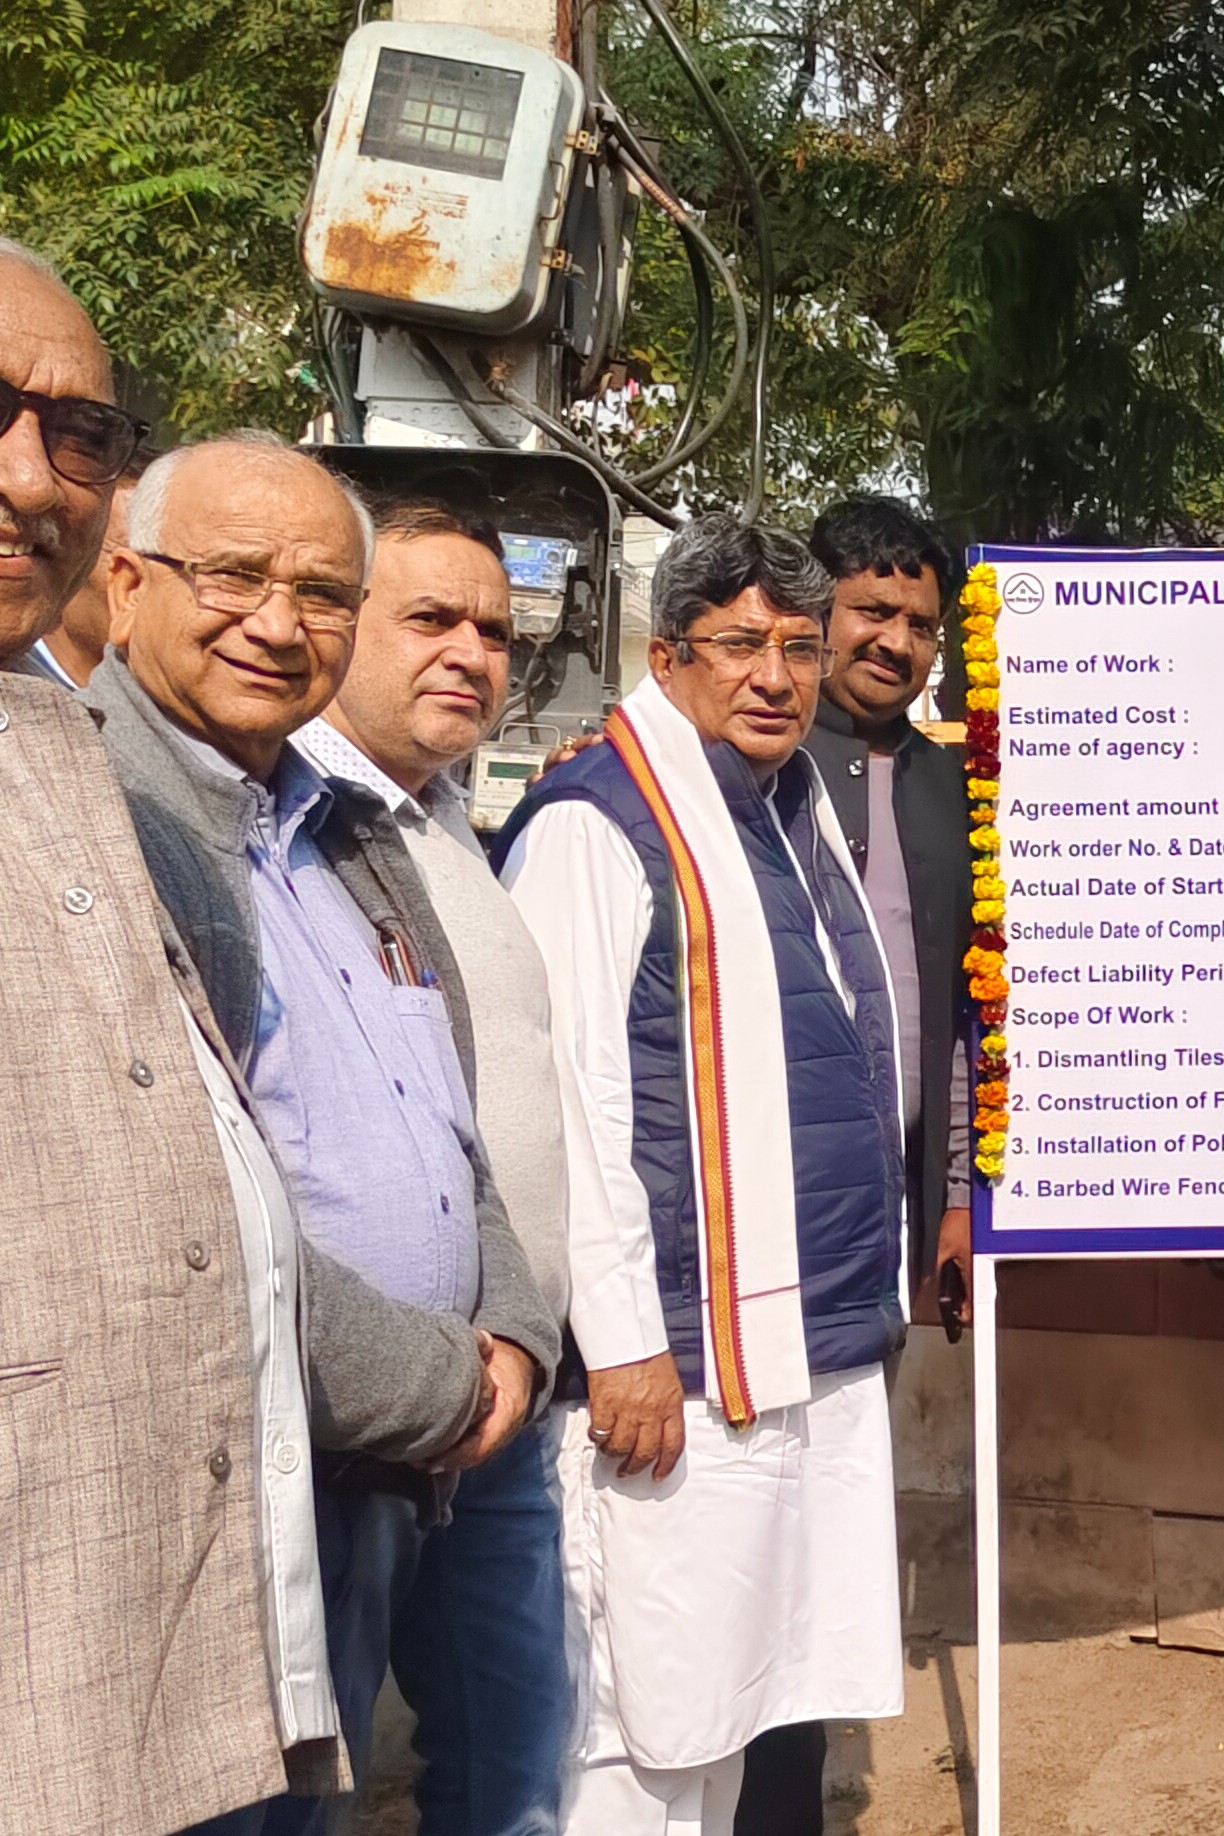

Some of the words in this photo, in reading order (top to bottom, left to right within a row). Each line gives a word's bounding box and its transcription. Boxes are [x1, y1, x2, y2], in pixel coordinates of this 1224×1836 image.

[1007, 656, 1068, 673] Name
[1076, 655, 1098, 673] of
[1104, 655, 1160, 672] Work
[1168, 658, 1174, 673] :
[1009, 706, 1117, 724] Estimated
[1126, 706, 1176, 724] Cost
[1183, 709, 1189, 724] :
[1010, 739, 1070, 756] Name
[1079, 738, 1100, 756] of
[1107, 742, 1184, 760] agency
[1193, 741, 1199, 755] :
[1009, 799, 1130, 821] Agreement
[1137, 798, 1219, 815] amount
[1010, 840, 1062, 857] Work
[1069, 839, 1122, 857] order
[1129, 839, 1160, 856] No.
[1168, 838, 1182, 856] &
[1010, 878, 1079, 896] Actual
[1088, 878, 1136, 896] Date
[1144, 877, 1165, 895] of
[1172, 877, 1223, 895] Start
[1011, 922, 1093, 940] Schedule
[1100, 921, 1140, 938] Date
[1146, 920, 1164, 938] of
[1012, 966, 1081, 983] Defect
[1089, 964, 1174, 986] Liability
[1012, 1008, 1079, 1029] Scope
[1087, 1007, 1112, 1024] Of
[1118, 1006, 1174, 1024] Work
[1182, 1009, 1187, 1024] :
[1013, 1051, 1029, 1068] 1.
[1038, 1049, 1166, 1071] Dismantling
[1174, 1048, 1224, 1066] Tiles
[1012, 1094, 1029, 1111] 2.
[1038, 1092, 1178, 1111] Construction
[1186, 1091, 1207, 1109] of
[1012, 1137, 1029, 1154] 3.
[1038, 1135, 1156, 1154] Installation
[1164, 1134, 1186, 1152] of
[1011, 1180, 1029, 1197] 4.
[1038, 1179, 1114, 1197] Barbed
[1122, 1178, 1170, 1196] Wire
